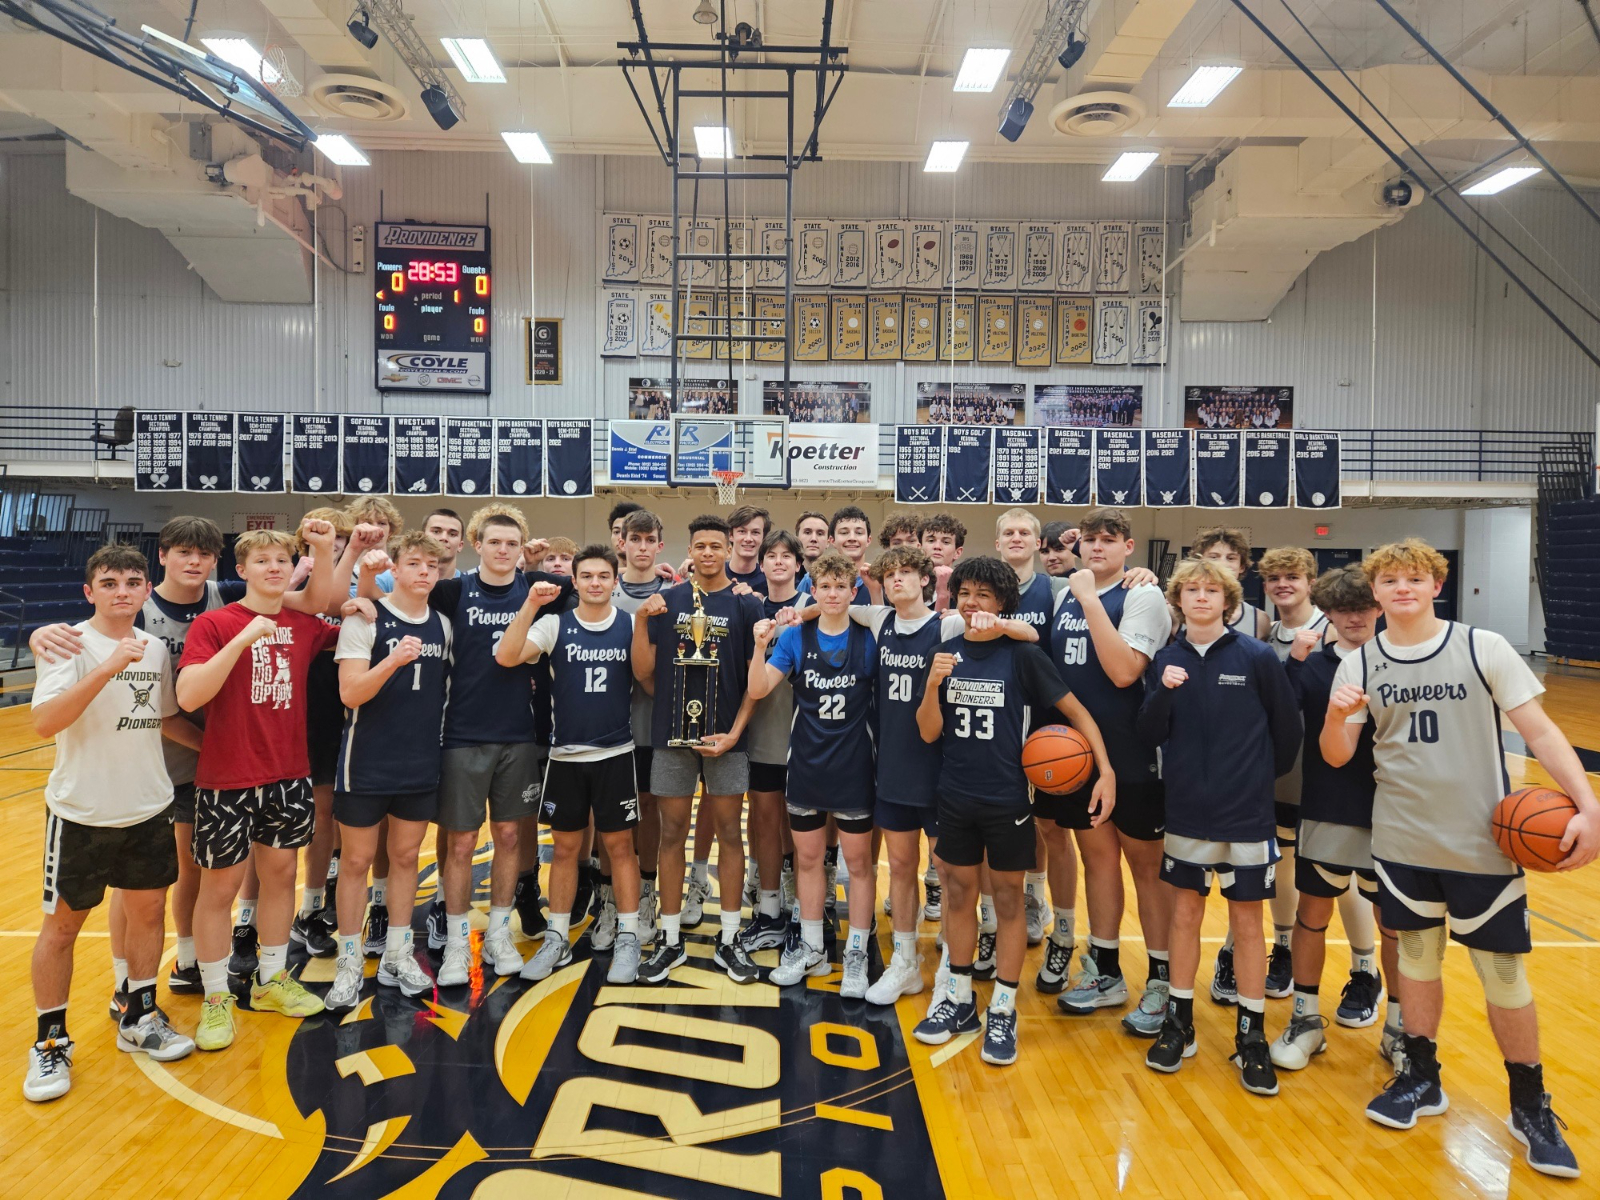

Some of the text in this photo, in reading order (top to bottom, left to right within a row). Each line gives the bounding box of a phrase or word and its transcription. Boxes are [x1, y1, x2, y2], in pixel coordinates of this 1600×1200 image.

[384, 226, 477, 247] PROVIDENCE
[378, 262, 402, 271] Pioneers
[408, 262, 457, 282] 28:53
[462, 265, 485, 274] Guests
[392, 272, 403, 291] 0
[476, 276, 487, 294] 0
[421, 305, 443, 314] player
[384, 314, 394, 329] 0
[474, 318, 483, 333] 0
[538, 329, 548, 339] G
[410, 357, 468, 367] COYLE
[770, 441, 865, 460] Koetter
[246, 521, 275, 531] EXIT
[466, 606, 518, 626] Pionee
[252, 646, 271, 664] IS
[565, 643, 626, 662] Pioneers
[880, 646, 926, 669] Pioneer
[1064, 637, 1087, 664] 50
[252, 666, 272, 685] NO
[412, 664, 421, 690] 1
[584, 667, 607, 692] 12
[949, 678, 1002, 692] PROVIDENCE
[251, 683, 292, 704] OPTION
[889, 673, 912, 702] 20
[1377, 681, 1467, 708] Pioneers
[819, 694, 845, 720] 22
[955, 692, 995, 704] PIONEERS
[116, 717, 162, 731] PIONEER
[955, 707, 994, 740] 33
[1408, 710, 1439, 743] 10
